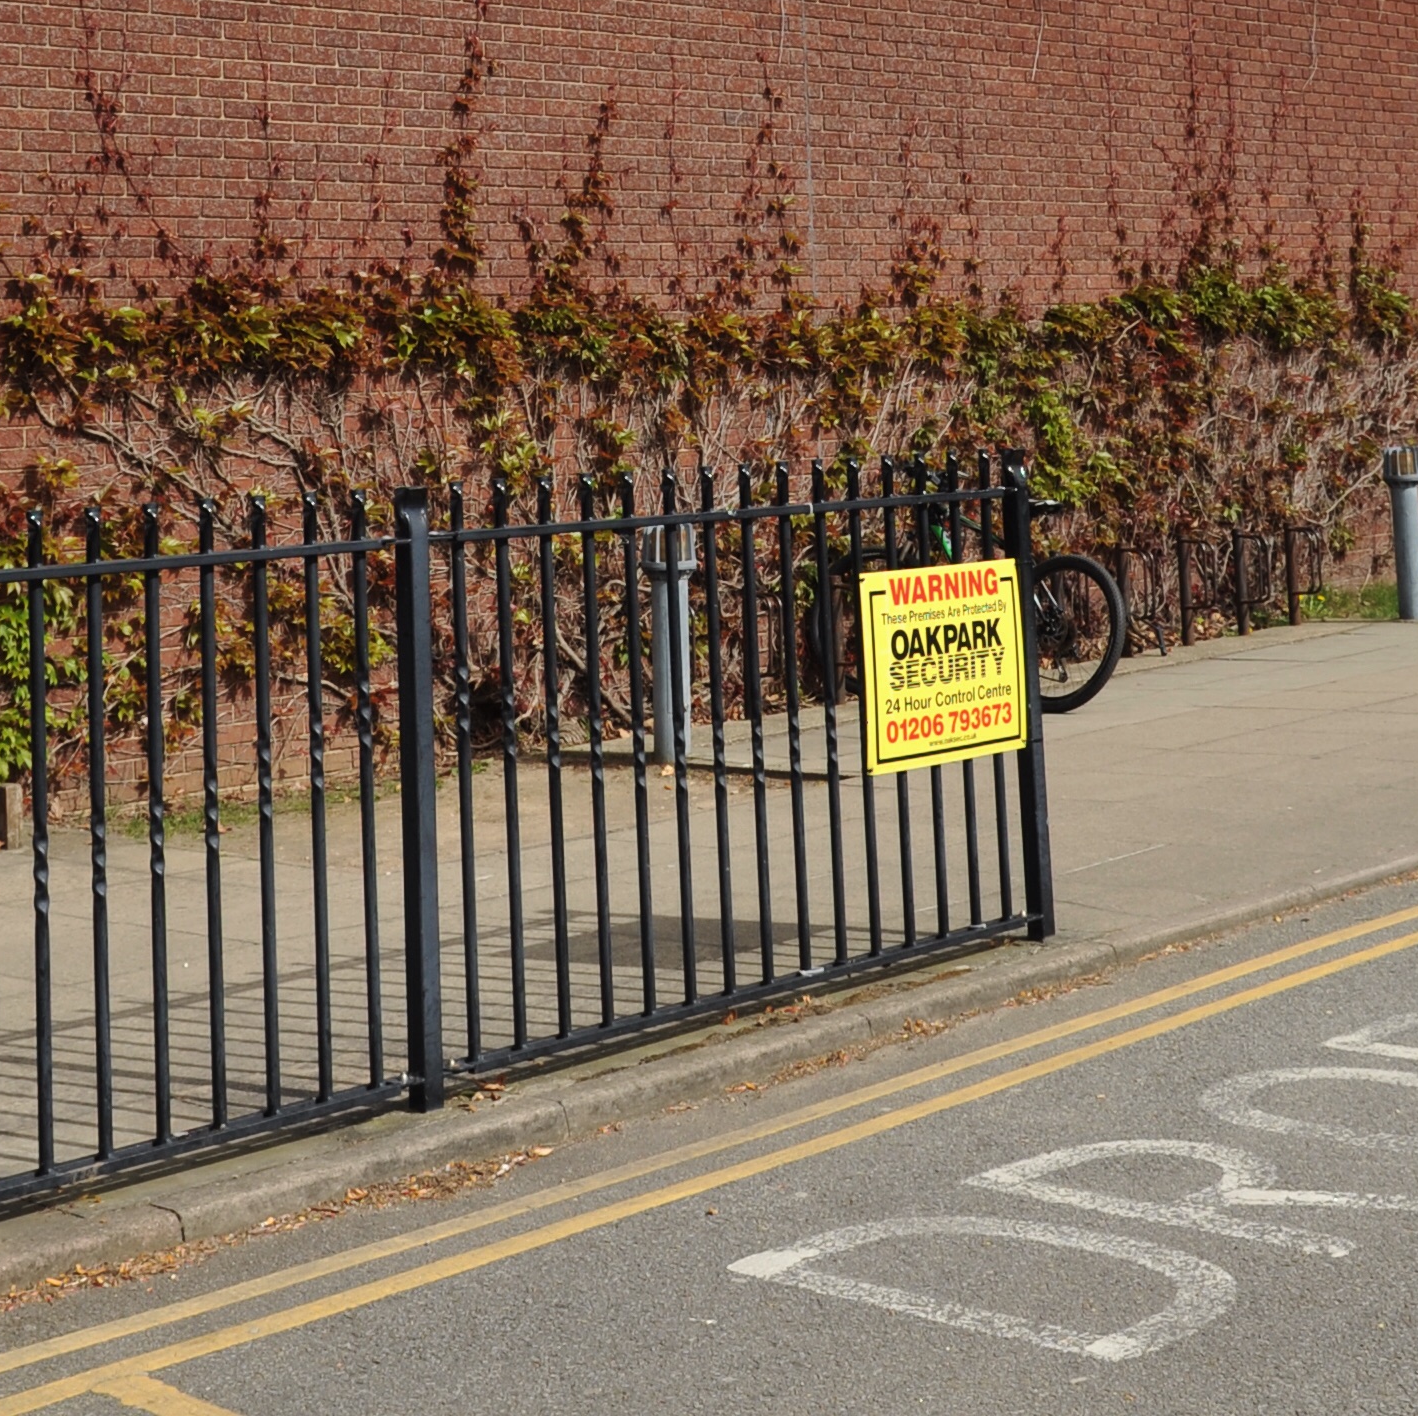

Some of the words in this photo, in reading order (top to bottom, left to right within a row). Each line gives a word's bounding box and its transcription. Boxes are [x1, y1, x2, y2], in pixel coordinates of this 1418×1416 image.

[889, 567, 999, 606] WARNING
[881, 612, 907, 625] These
[909, 606, 945, 622] Premises
[947, 606, 961, 617] Are
[963, 601, 997, 615] Protected
[998, 600, 1007, 614] By
[891, 617, 1003, 661] OAKPARK
[889, 646, 1005, 691] SECURITY
[885, 698, 901, 715] 24
[904, 695, 932, 711] Hour
[935, 687, 976, 707] Control
[978, 683, 1012, 700] Centre
[886, 713, 944, 744] 01206
[949, 702, 1012, 734] 793673
